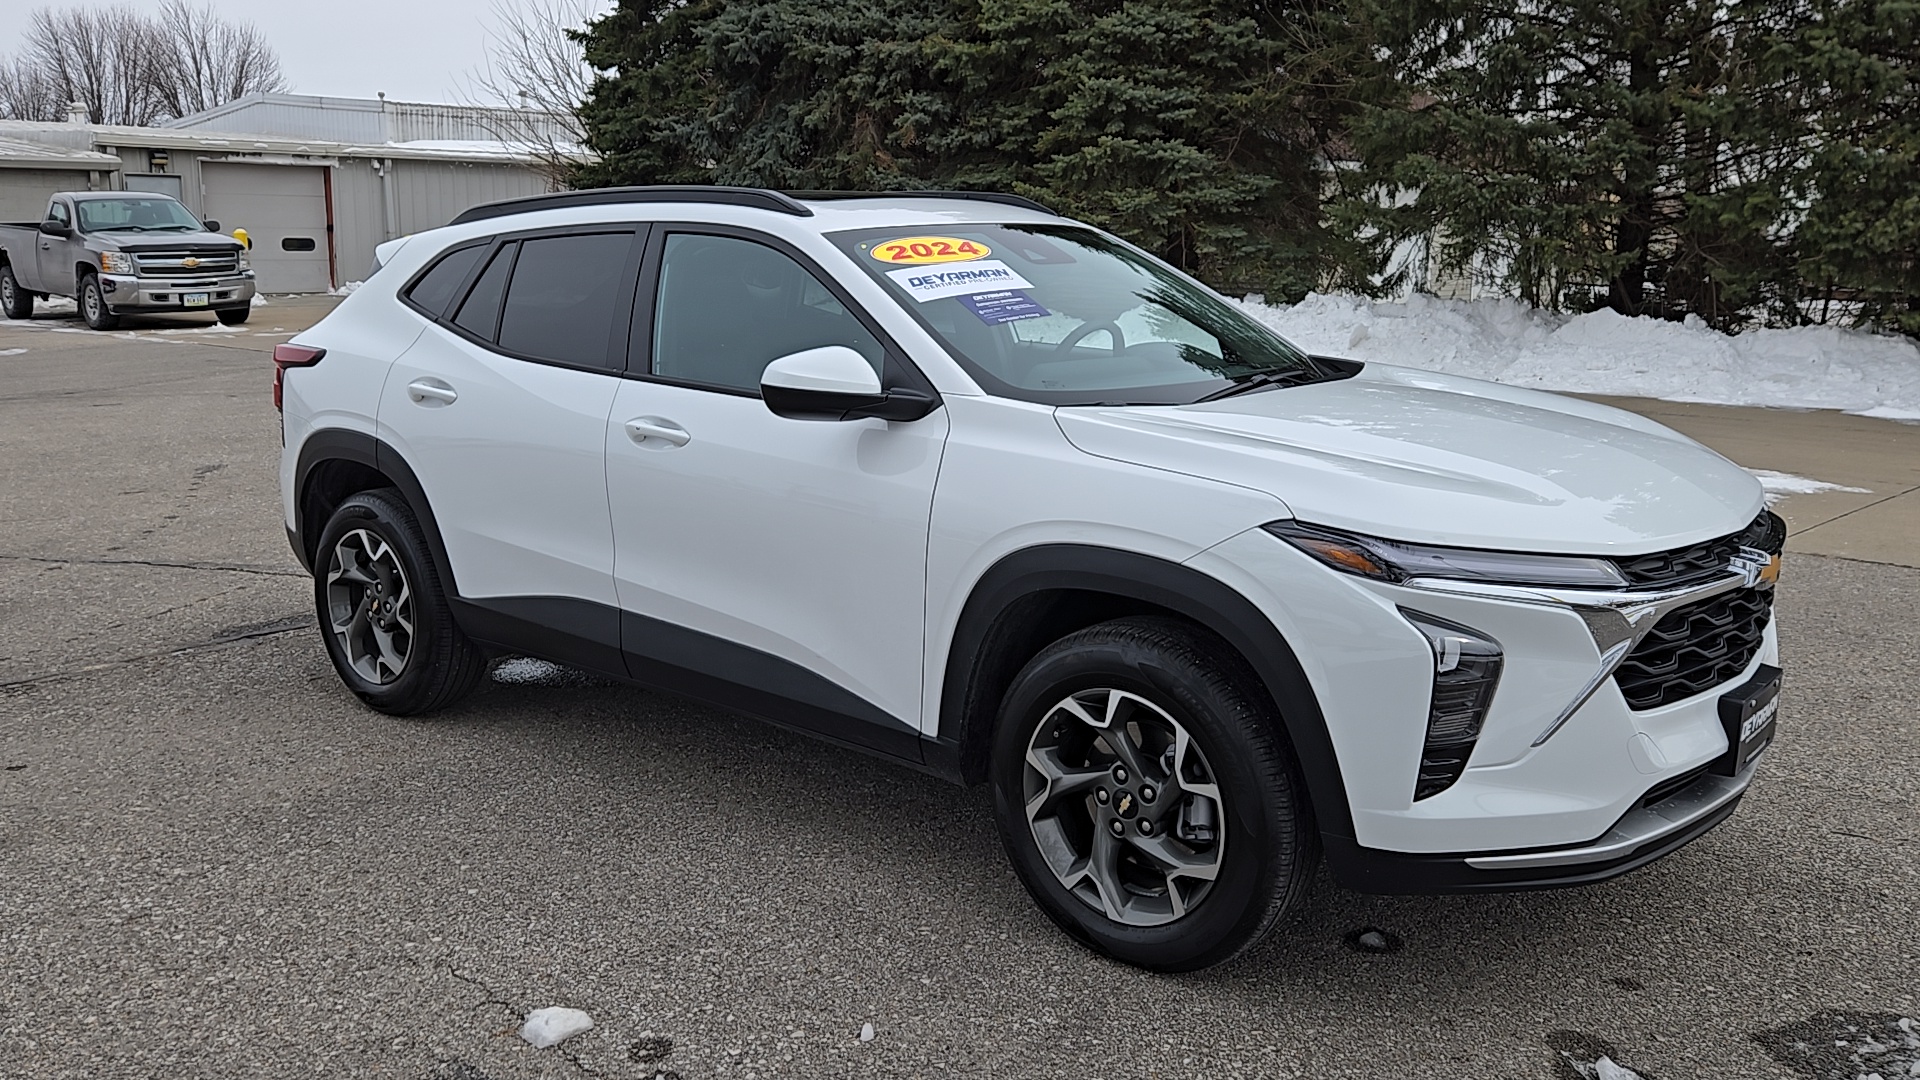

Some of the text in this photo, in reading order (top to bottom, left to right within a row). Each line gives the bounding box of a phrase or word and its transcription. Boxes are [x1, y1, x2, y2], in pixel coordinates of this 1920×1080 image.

[887, 242, 981, 261] 2024
[908, 268, 1010, 287] DEYARMAN
[924, 280, 967, 290] CERTIFIED
